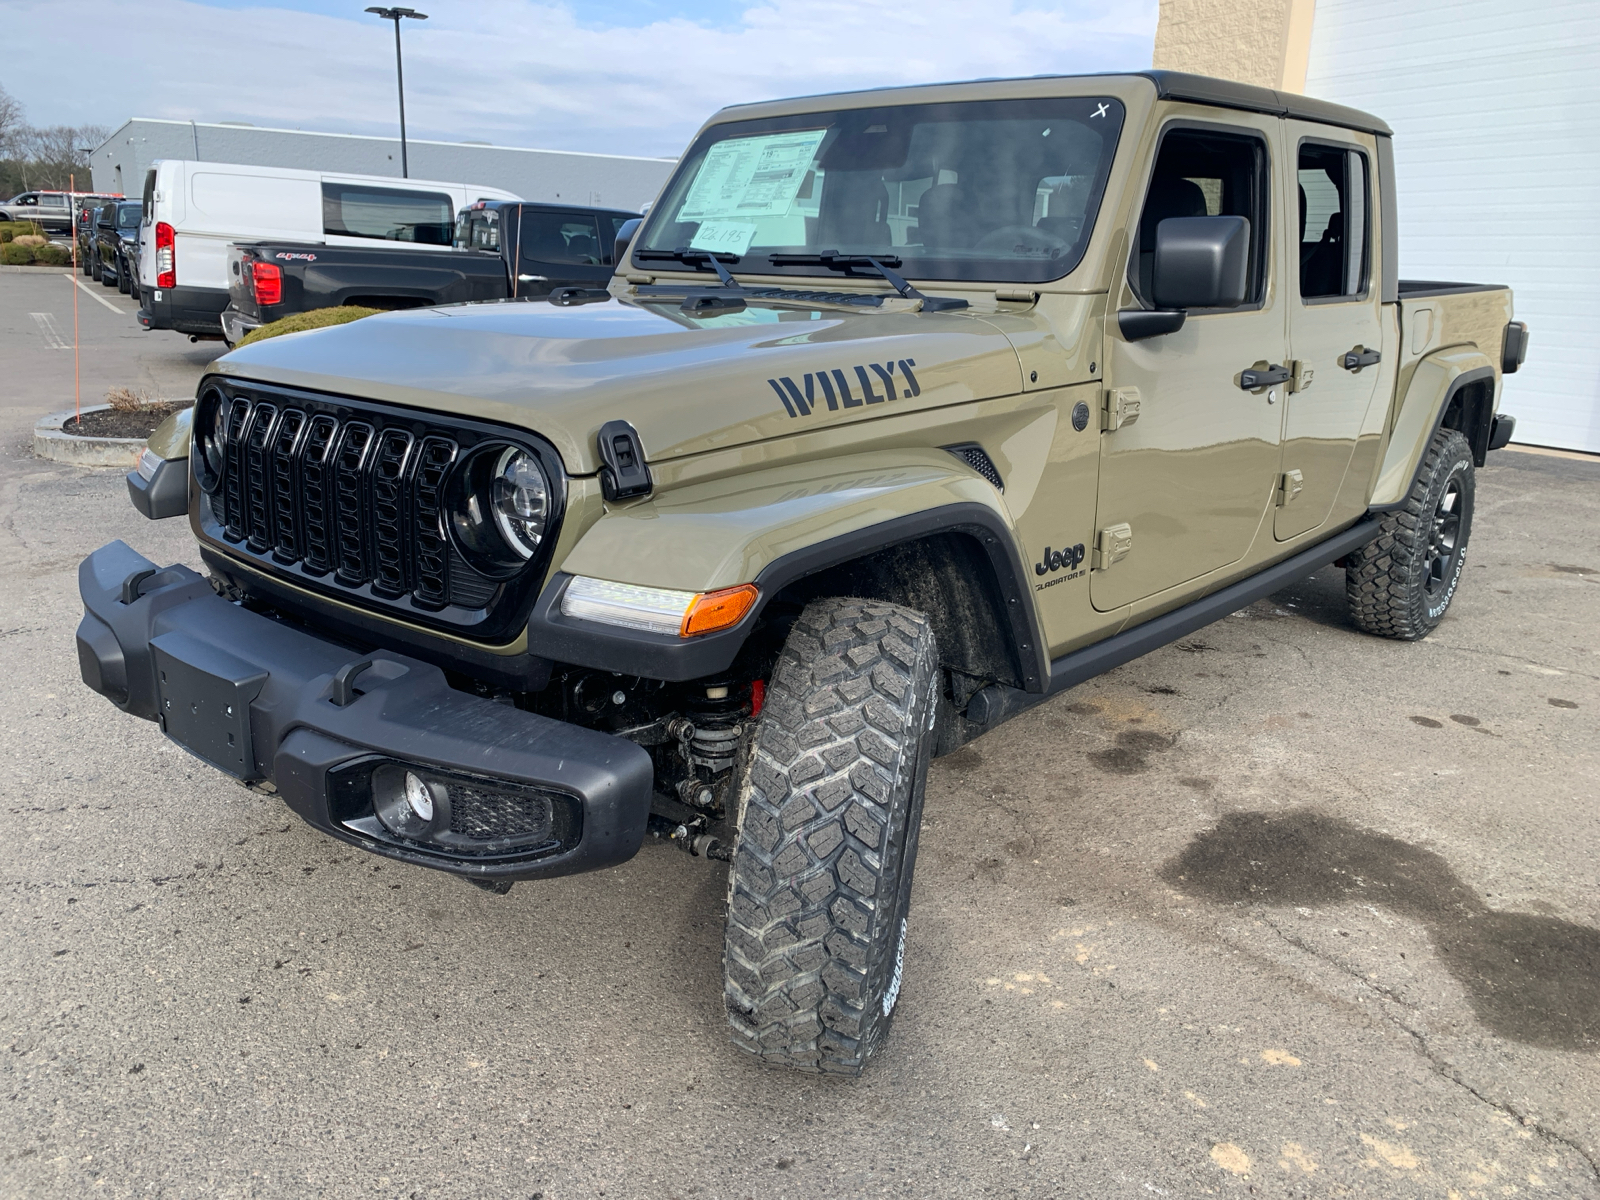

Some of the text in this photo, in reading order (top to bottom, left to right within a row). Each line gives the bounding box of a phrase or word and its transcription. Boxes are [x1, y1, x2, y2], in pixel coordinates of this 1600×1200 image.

[767, 358, 920, 418] WILLYS
[1035, 543, 1085, 576] Jeep
[1035, 571, 1079, 591] GLADIATOR
